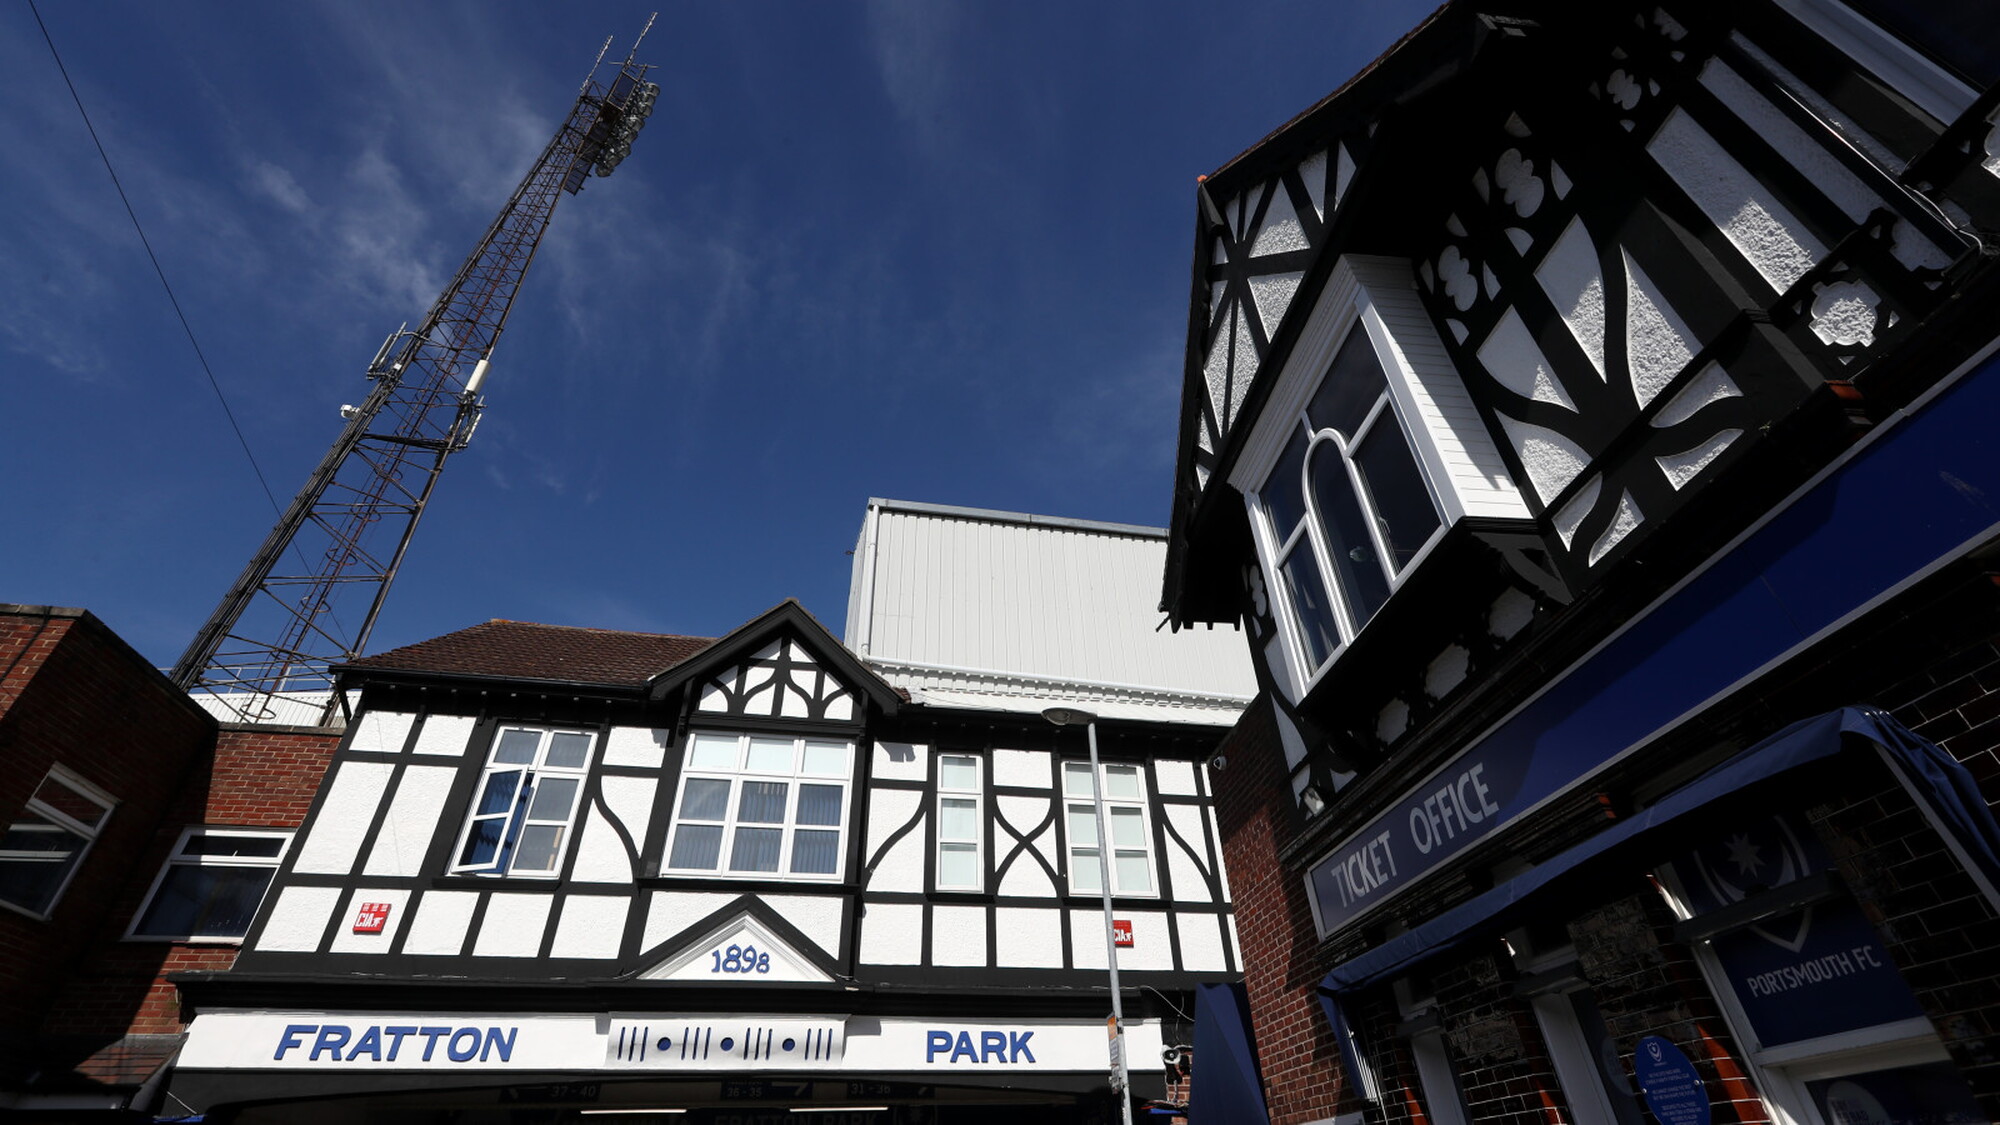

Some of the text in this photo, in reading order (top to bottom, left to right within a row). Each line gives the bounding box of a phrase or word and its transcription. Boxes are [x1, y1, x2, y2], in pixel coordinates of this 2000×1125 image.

[1331, 762, 1499, 908] TICKET OFFICE
[711, 943, 770, 974] 1898
[1746, 945, 1882, 998] PORTSMOUTH FC
[273, 1024, 1036, 1064] FRATTON PARK
